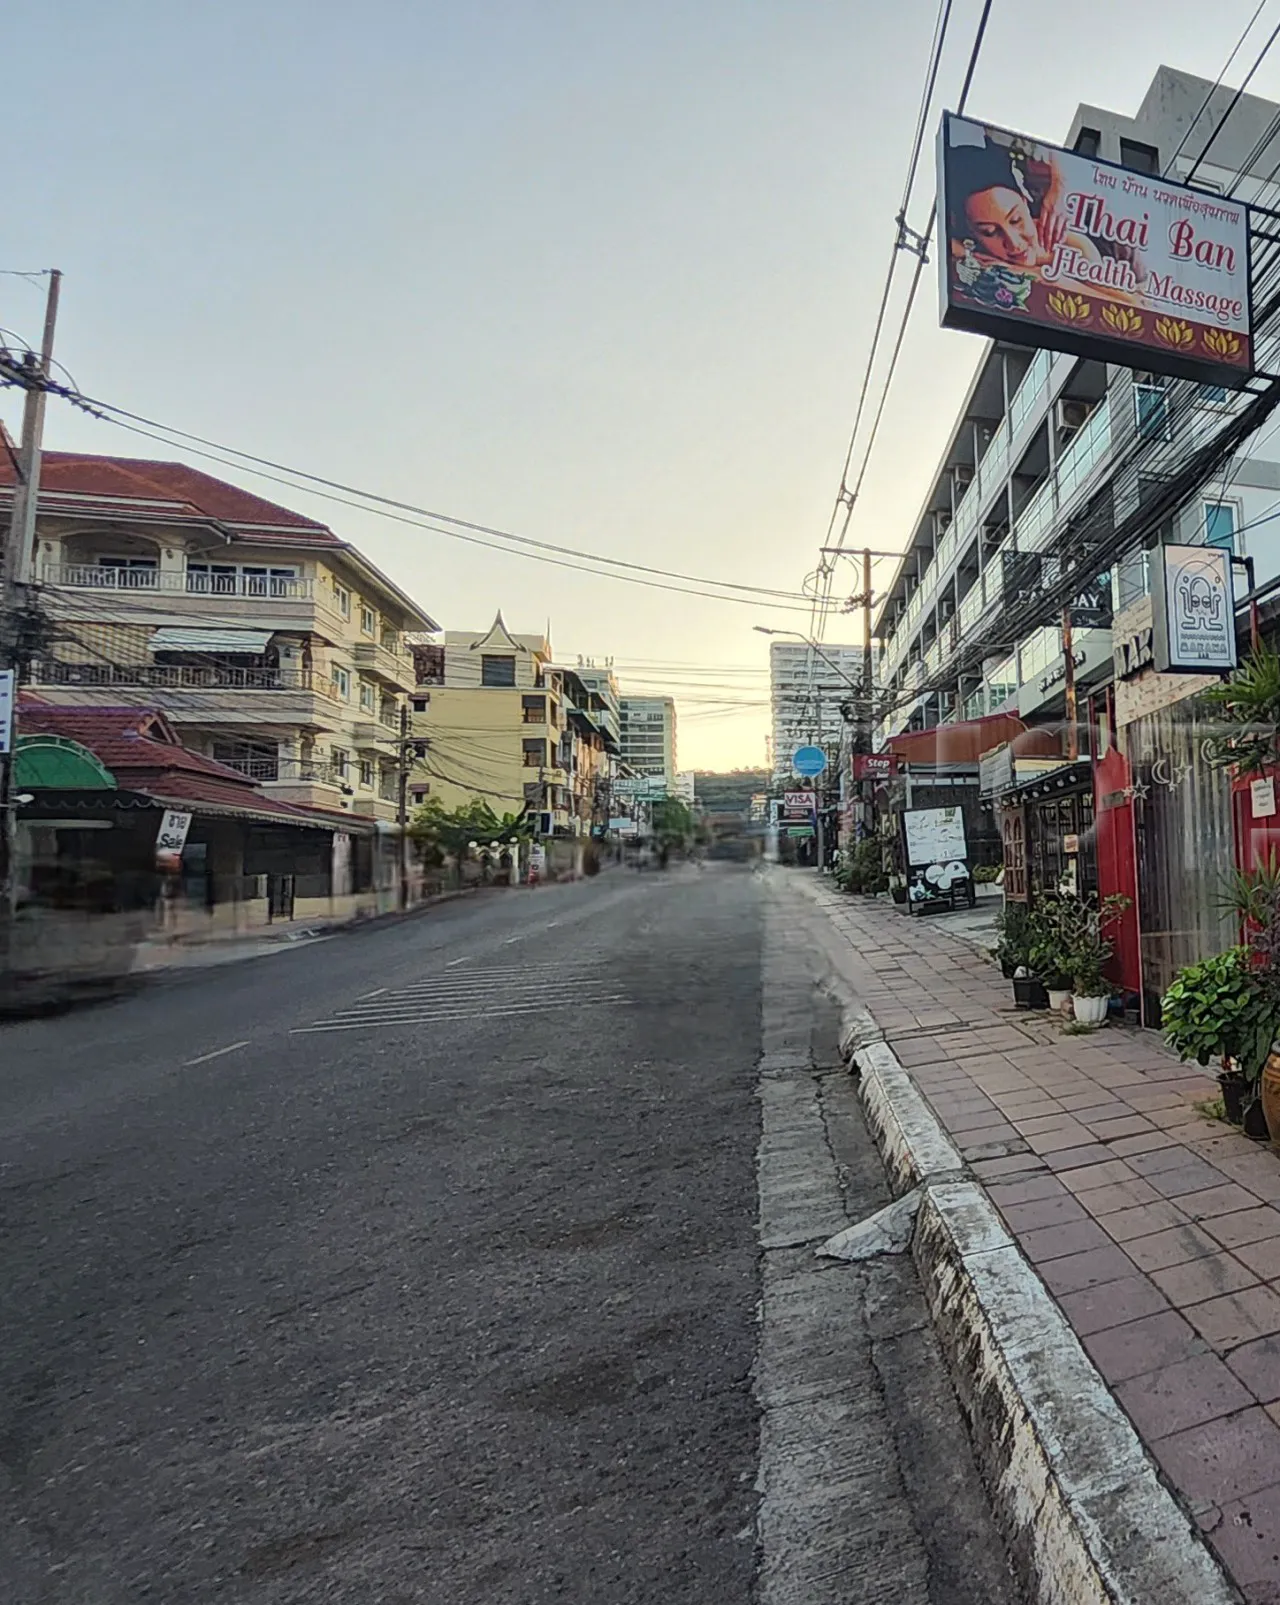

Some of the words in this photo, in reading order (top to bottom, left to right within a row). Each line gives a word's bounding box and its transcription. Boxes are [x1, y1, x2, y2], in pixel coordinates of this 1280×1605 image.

[1091, 165, 1117, 189] ไทย
[1066, 191, 1149, 250] Thai
[1168, 217, 1236, 273] Ban
[1043, 244, 1137, 292] Health
[1145, 270, 1244, 324] Massage
[867, 758, 891, 769] Step
[786, 794, 813, 804] VISA
[160, 833, 183, 849] Sale
